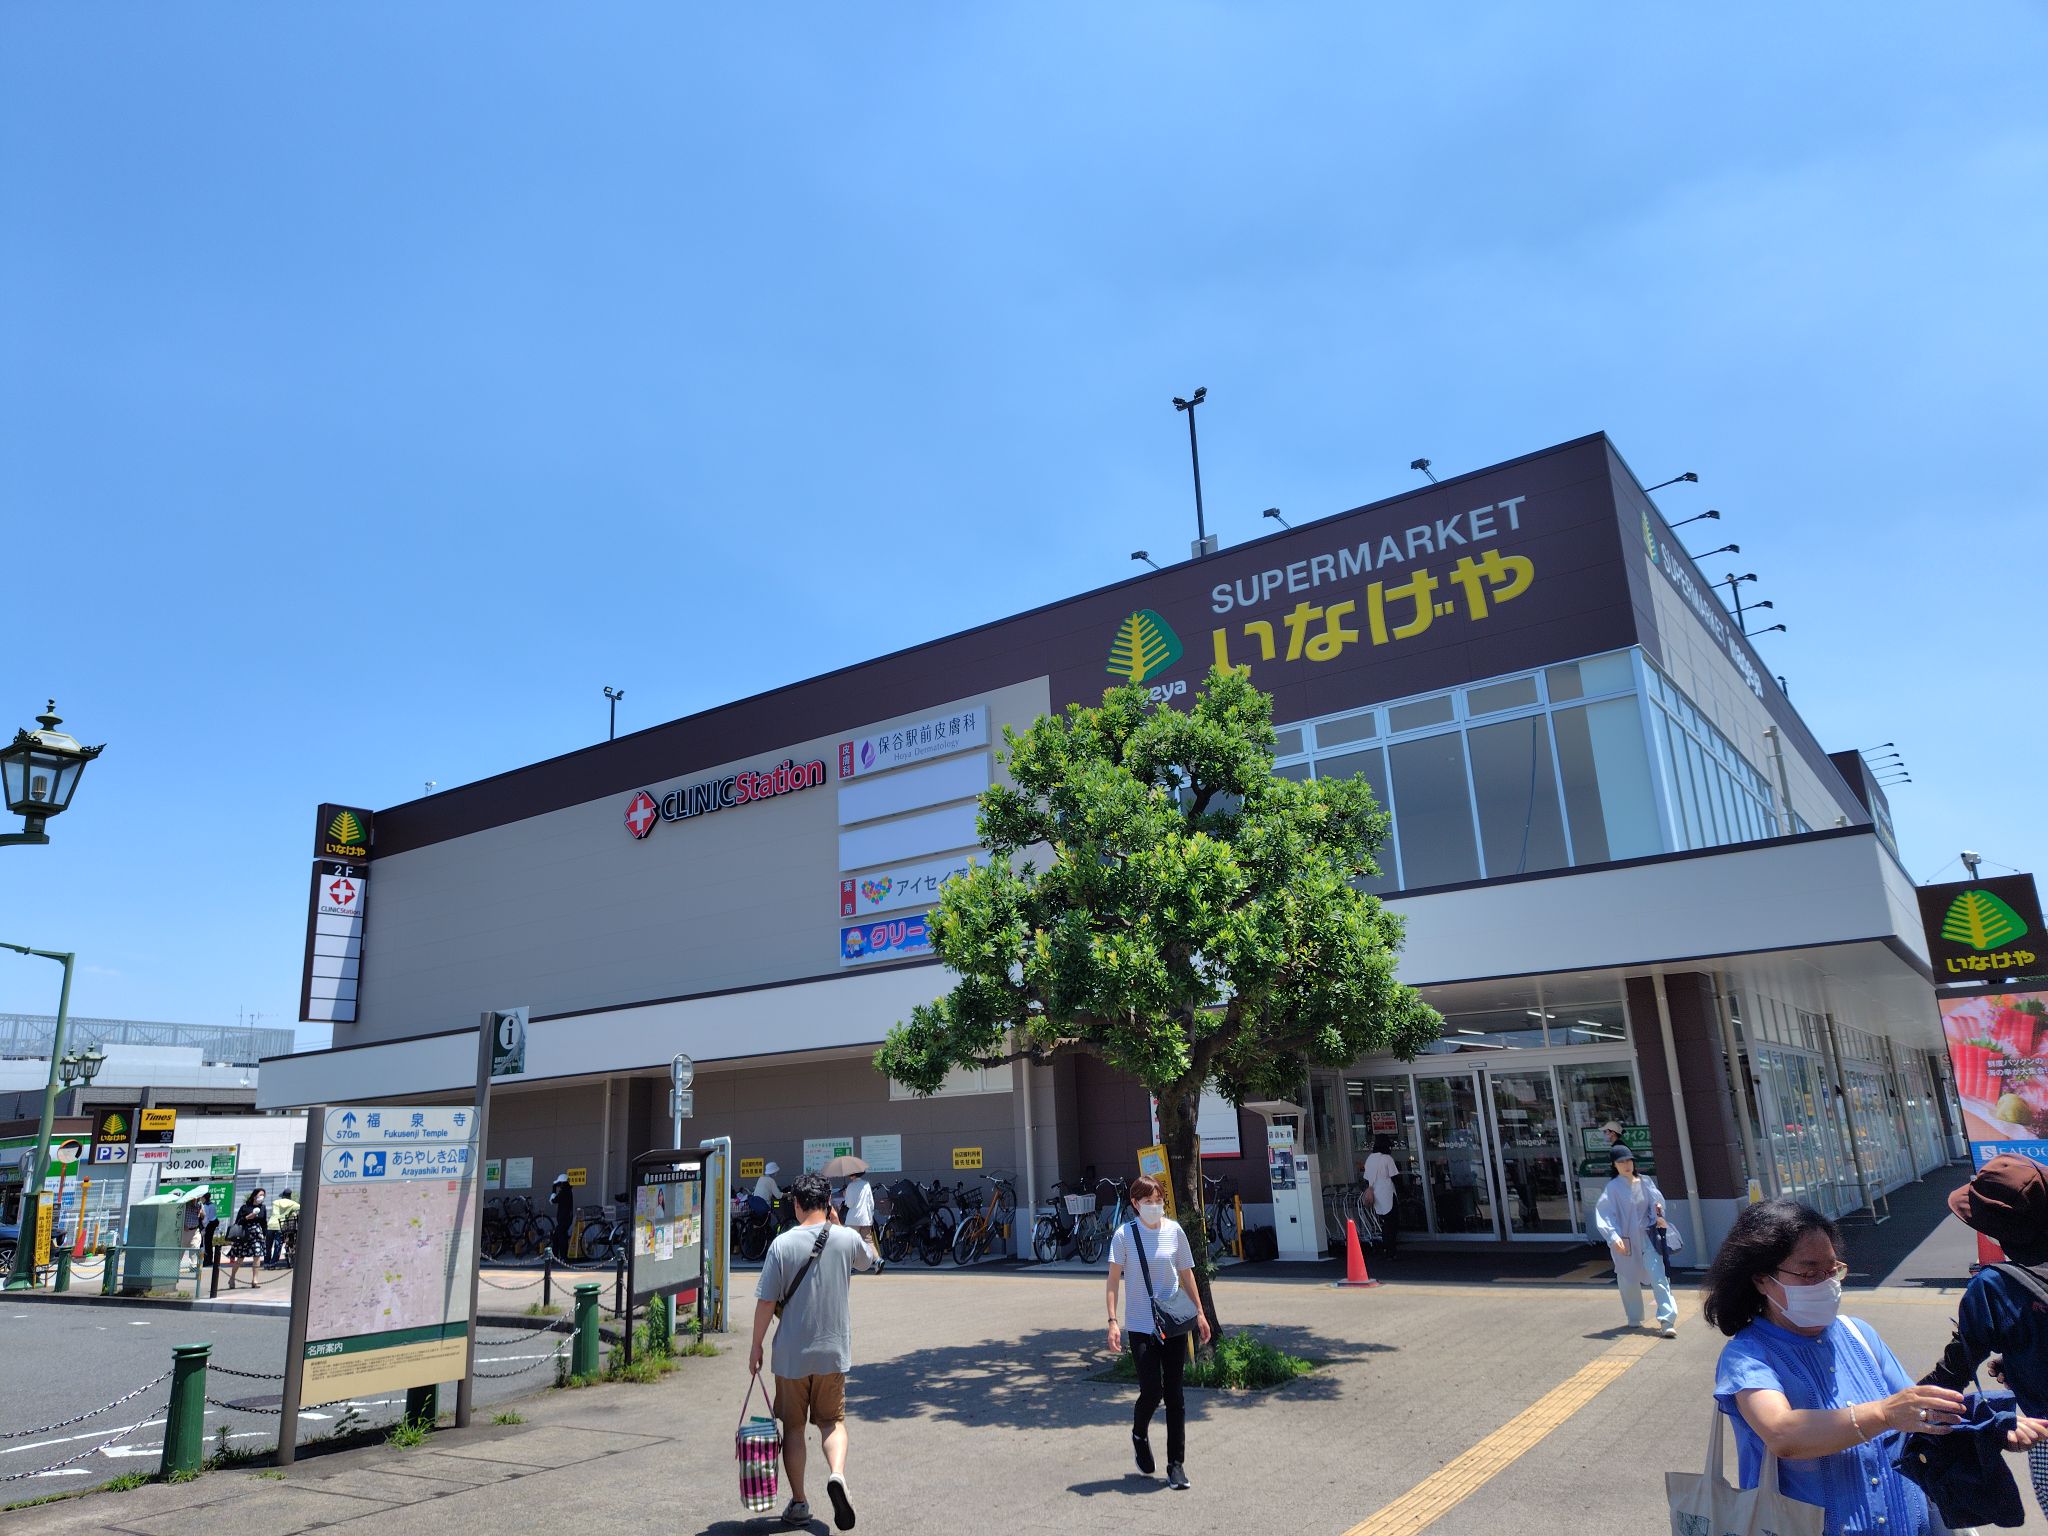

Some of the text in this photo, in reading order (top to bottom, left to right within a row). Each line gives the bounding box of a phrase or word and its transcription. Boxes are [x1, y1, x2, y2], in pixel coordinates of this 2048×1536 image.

[1211, 495, 1526, 614] SUPERMARKET
[1661, 542, 1726, 648] SUPERMARKET
[1212, 549, 1535, 678] いなげや
[878, 712, 976, 755] 保谷駅前皮膚科
[894, 739, 959, 761] Hoya Dermatology
[326, 843, 366, 857] いなげや
[843, 880, 853, 914] 薬局
[870, 921, 930, 949] クリー
[1947, 950, 2036, 973] いなげや
[1987, 1058, 2043, 1068] 鮮度バツグンの
[145, 1113, 173, 1121] Times
[336, 1129, 448, 1139] 570m Fukusenji Temple
[1516, 1138, 1547, 1147] inageya
[392, 1148, 469, 1165] あらやしき公園
[333, 1166, 457, 1179] 200m Arayashiki Park
[307, 1342, 344, 1356] 名所案内
